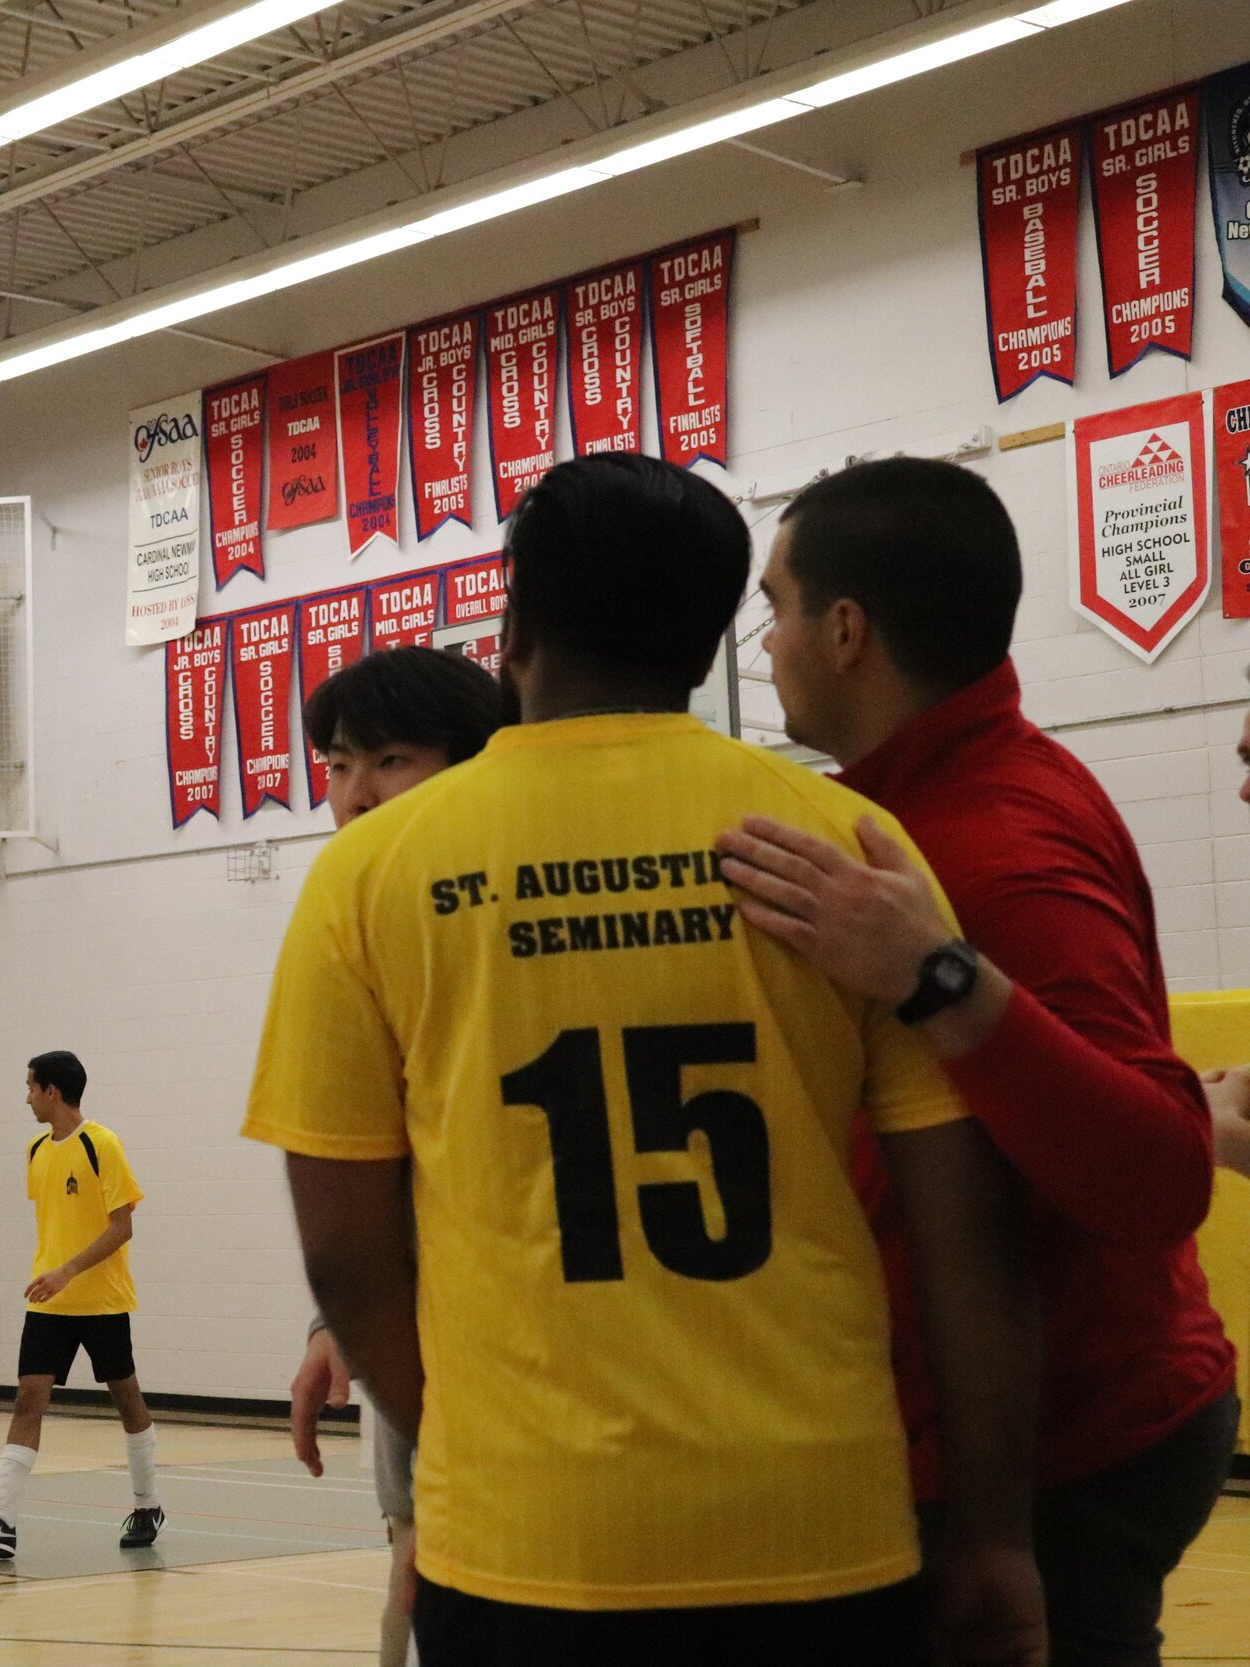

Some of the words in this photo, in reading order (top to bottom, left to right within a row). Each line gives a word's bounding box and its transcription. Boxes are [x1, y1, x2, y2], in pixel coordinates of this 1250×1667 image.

[1104, 102, 1190, 151] TDCAA
[992, 137, 1072, 184] TDCAA
[1102, 157, 1131, 177] SR.
[1134, 135, 1190, 166] GIRLS
[991, 186, 1021, 206] SR.
[1026, 167, 1071, 197] BOYS
[1135, 172, 1161, 290] SOCCER
[660, 245, 723, 284] TDCAA
[1023, 202, 1047, 319] BASEBALL
[575, 271, 636, 309] TDCAA
[660, 289, 683, 307] SR.
[685, 274, 722, 301] GIRLS
[494, 296, 553, 332] TDCAA
[575, 309, 597, 328] SR.
[600, 295, 635, 320] BOYS
[1111, 287, 1189, 325] CHAMPIONS
[417, 321, 472, 356] TDCAA
[490, 333, 517, 352] MID.
[519, 320, 554, 345] GIRLS
[998, 316, 1072, 352] CHAMPIONS
[1130, 315, 1175, 344] 2005
[417, 355, 437, 373] JR.
[440, 345, 472, 367] BOYS
[581, 326, 602, 406] CROSS
[684, 303, 705, 406] SOFTBALL
[1017, 343, 1061, 371] 2005
[614, 316, 632, 430] COUNTRY
[211, 388, 260, 420] TDCAA
[500, 350, 522, 429] CROSS
[532, 342, 550, 450] COUNTRY
[211, 423, 229, 438] SR.
[230, 410, 261, 432] GIRLS
[422, 372, 442, 450] CROSS
[452, 364, 467, 472] COUNTRY
[669, 404, 721, 434] FINALISTS
[287, 416, 320, 437] TDCAA
[680, 427, 717, 451] 2005
[291, 443, 317, 463] 2004
[585, 431, 636, 456] FINALISTS
[499, 450, 554, 480] CHAMPIONS
[1098, 460, 1131, 476] ONTARIO
[1099, 460, 1185, 489] CHEERLEADING
[230, 434, 248, 526] SOCCER
[424, 474, 468, 499] FINALISTS
[1129, 473, 1185, 493] FEDERATION
[150, 507, 188, 528] TDCAA
[433, 494, 464, 515] 2005
[1104, 495, 1183, 523] Provincial
[215, 521, 259, 548] CHAMPIONS
[1101, 513, 1187, 539] Champions
[136, 547, 171, 567] CARDINAL
[227, 541, 255, 561] 2004
[1101, 542, 1133, 559] HIGH
[1137, 532, 1190, 552] SCHOOL
[1125, 550, 1166, 567] SMALL
[147, 567, 164, 584] HIGH
[1119, 567, 1141, 582] ALL
[1144, 562, 1174, 578] GIRL
[1123, 578, 1160, 595] LEVEL
[1163, 576, 1171, 588] 3
[131, 601, 167, 617] HOSTED
[168, 598, 180, 612] BY
[309, 597, 359, 627] TDCAA
[379, 583, 432, 615] TDCAA
[455, 598, 488, 618] OVERALL
[490, 593, 509, 612] BOYS
[1128, 593, 1167, 609] 2007
[241, 614, 289, 643] TDCAA
[308, 630, 327, 645] SR.
[327, 621, 359, 642] GIRLS
[376, 618, 400, 636] MID.
[401, 609, 435, 631] GIRLS
[176, 626, 222, 654] TDCAA
[240, 647, 258, 662] SR.
[259, 638, 289, 659] GIRLS
[173, 655, 191, 671] JR.
[194, 649, 221, 667] BOYS
[178, 672, 194, 740] CROSS
[204, 667, 216, 764] COUNTRY
[259, 660, 274, 752] SOCCER
[175, 765, 218, 786] CHAMPIONS
[246, 753, 290, 775] CHAMPIONS
[187, 784, 214, 801] 2007
[257, 773, 281, 790] 2007
[430, 871, 499, 916] ST.
[508, 903, 735, 959] SEMINARY
[500, 1021, 773, 1284] 15
